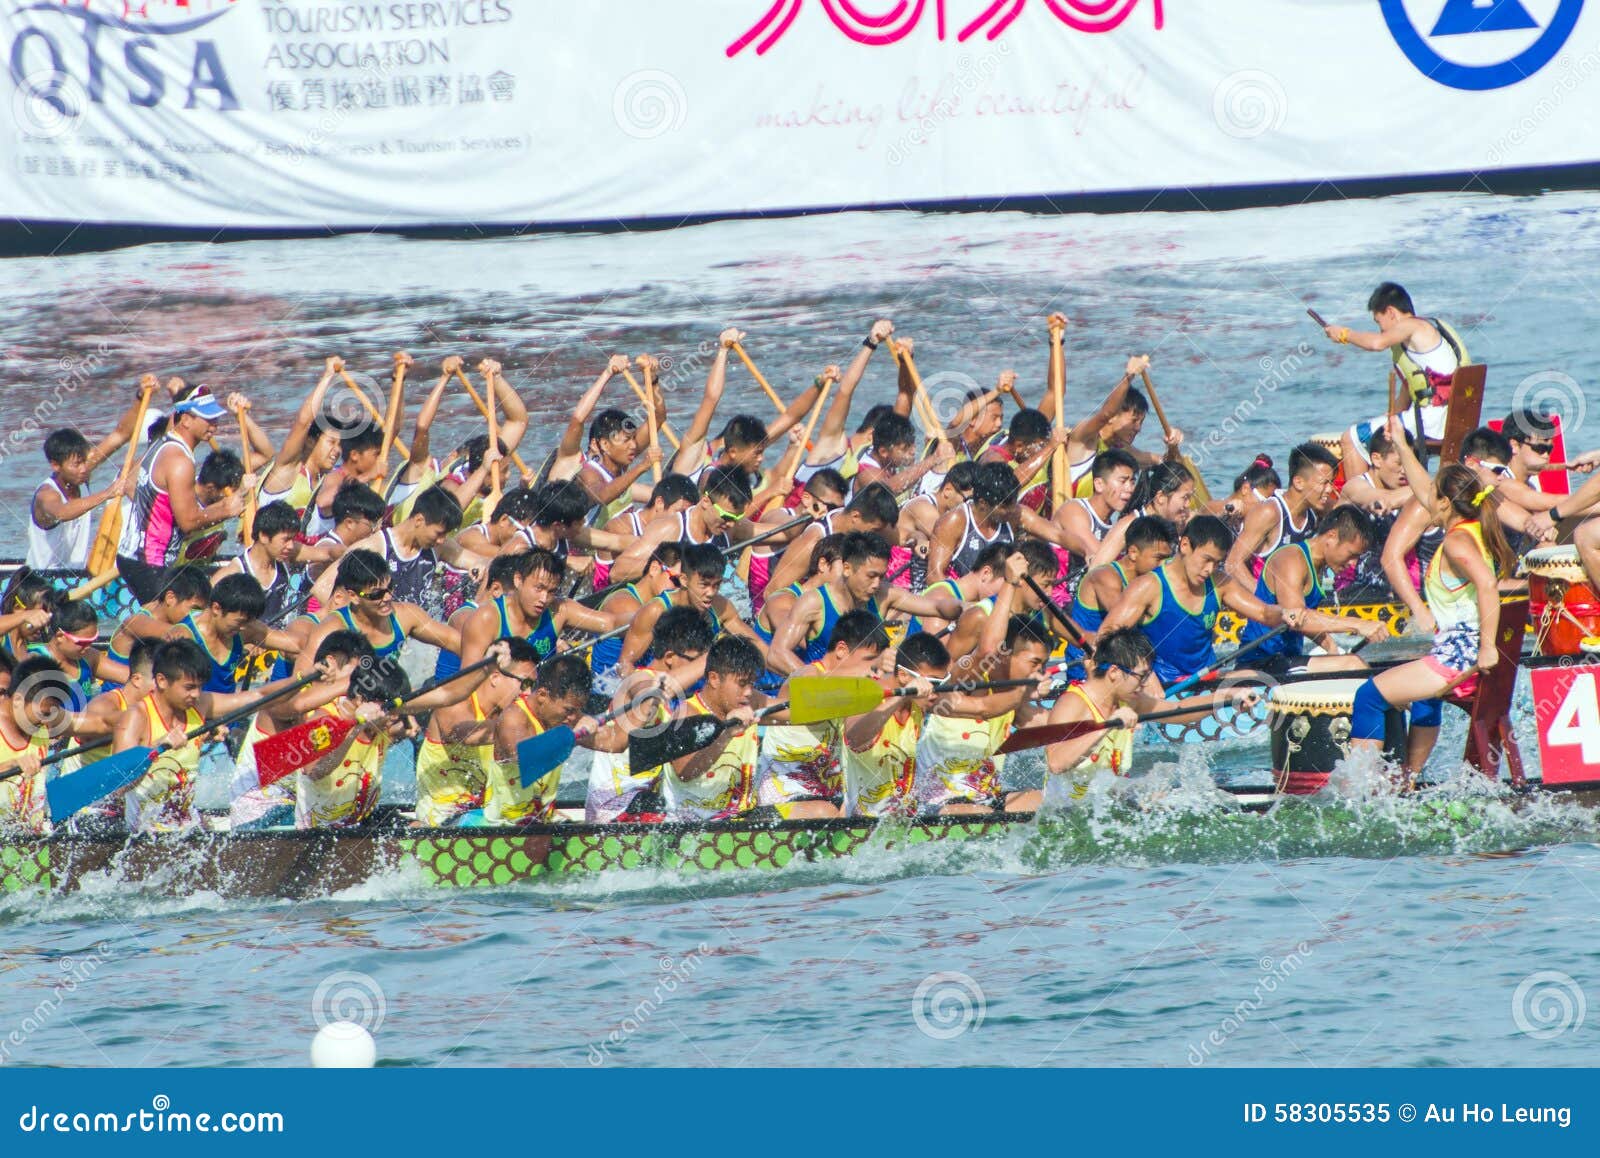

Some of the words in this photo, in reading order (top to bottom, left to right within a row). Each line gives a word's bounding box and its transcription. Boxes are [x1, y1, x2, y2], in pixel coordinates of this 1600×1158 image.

[262, 6, 383, 33] TOURISM
[388, 0, 512, 30] SERVICES
[264, 38, 450, 69] ASSOCIATION
[755, 80, 884, 150] making
[396, 138, 456, 154] Tourism
[461, 136, 522, 152] Services
[1546, 672, 1600, 765] 4
